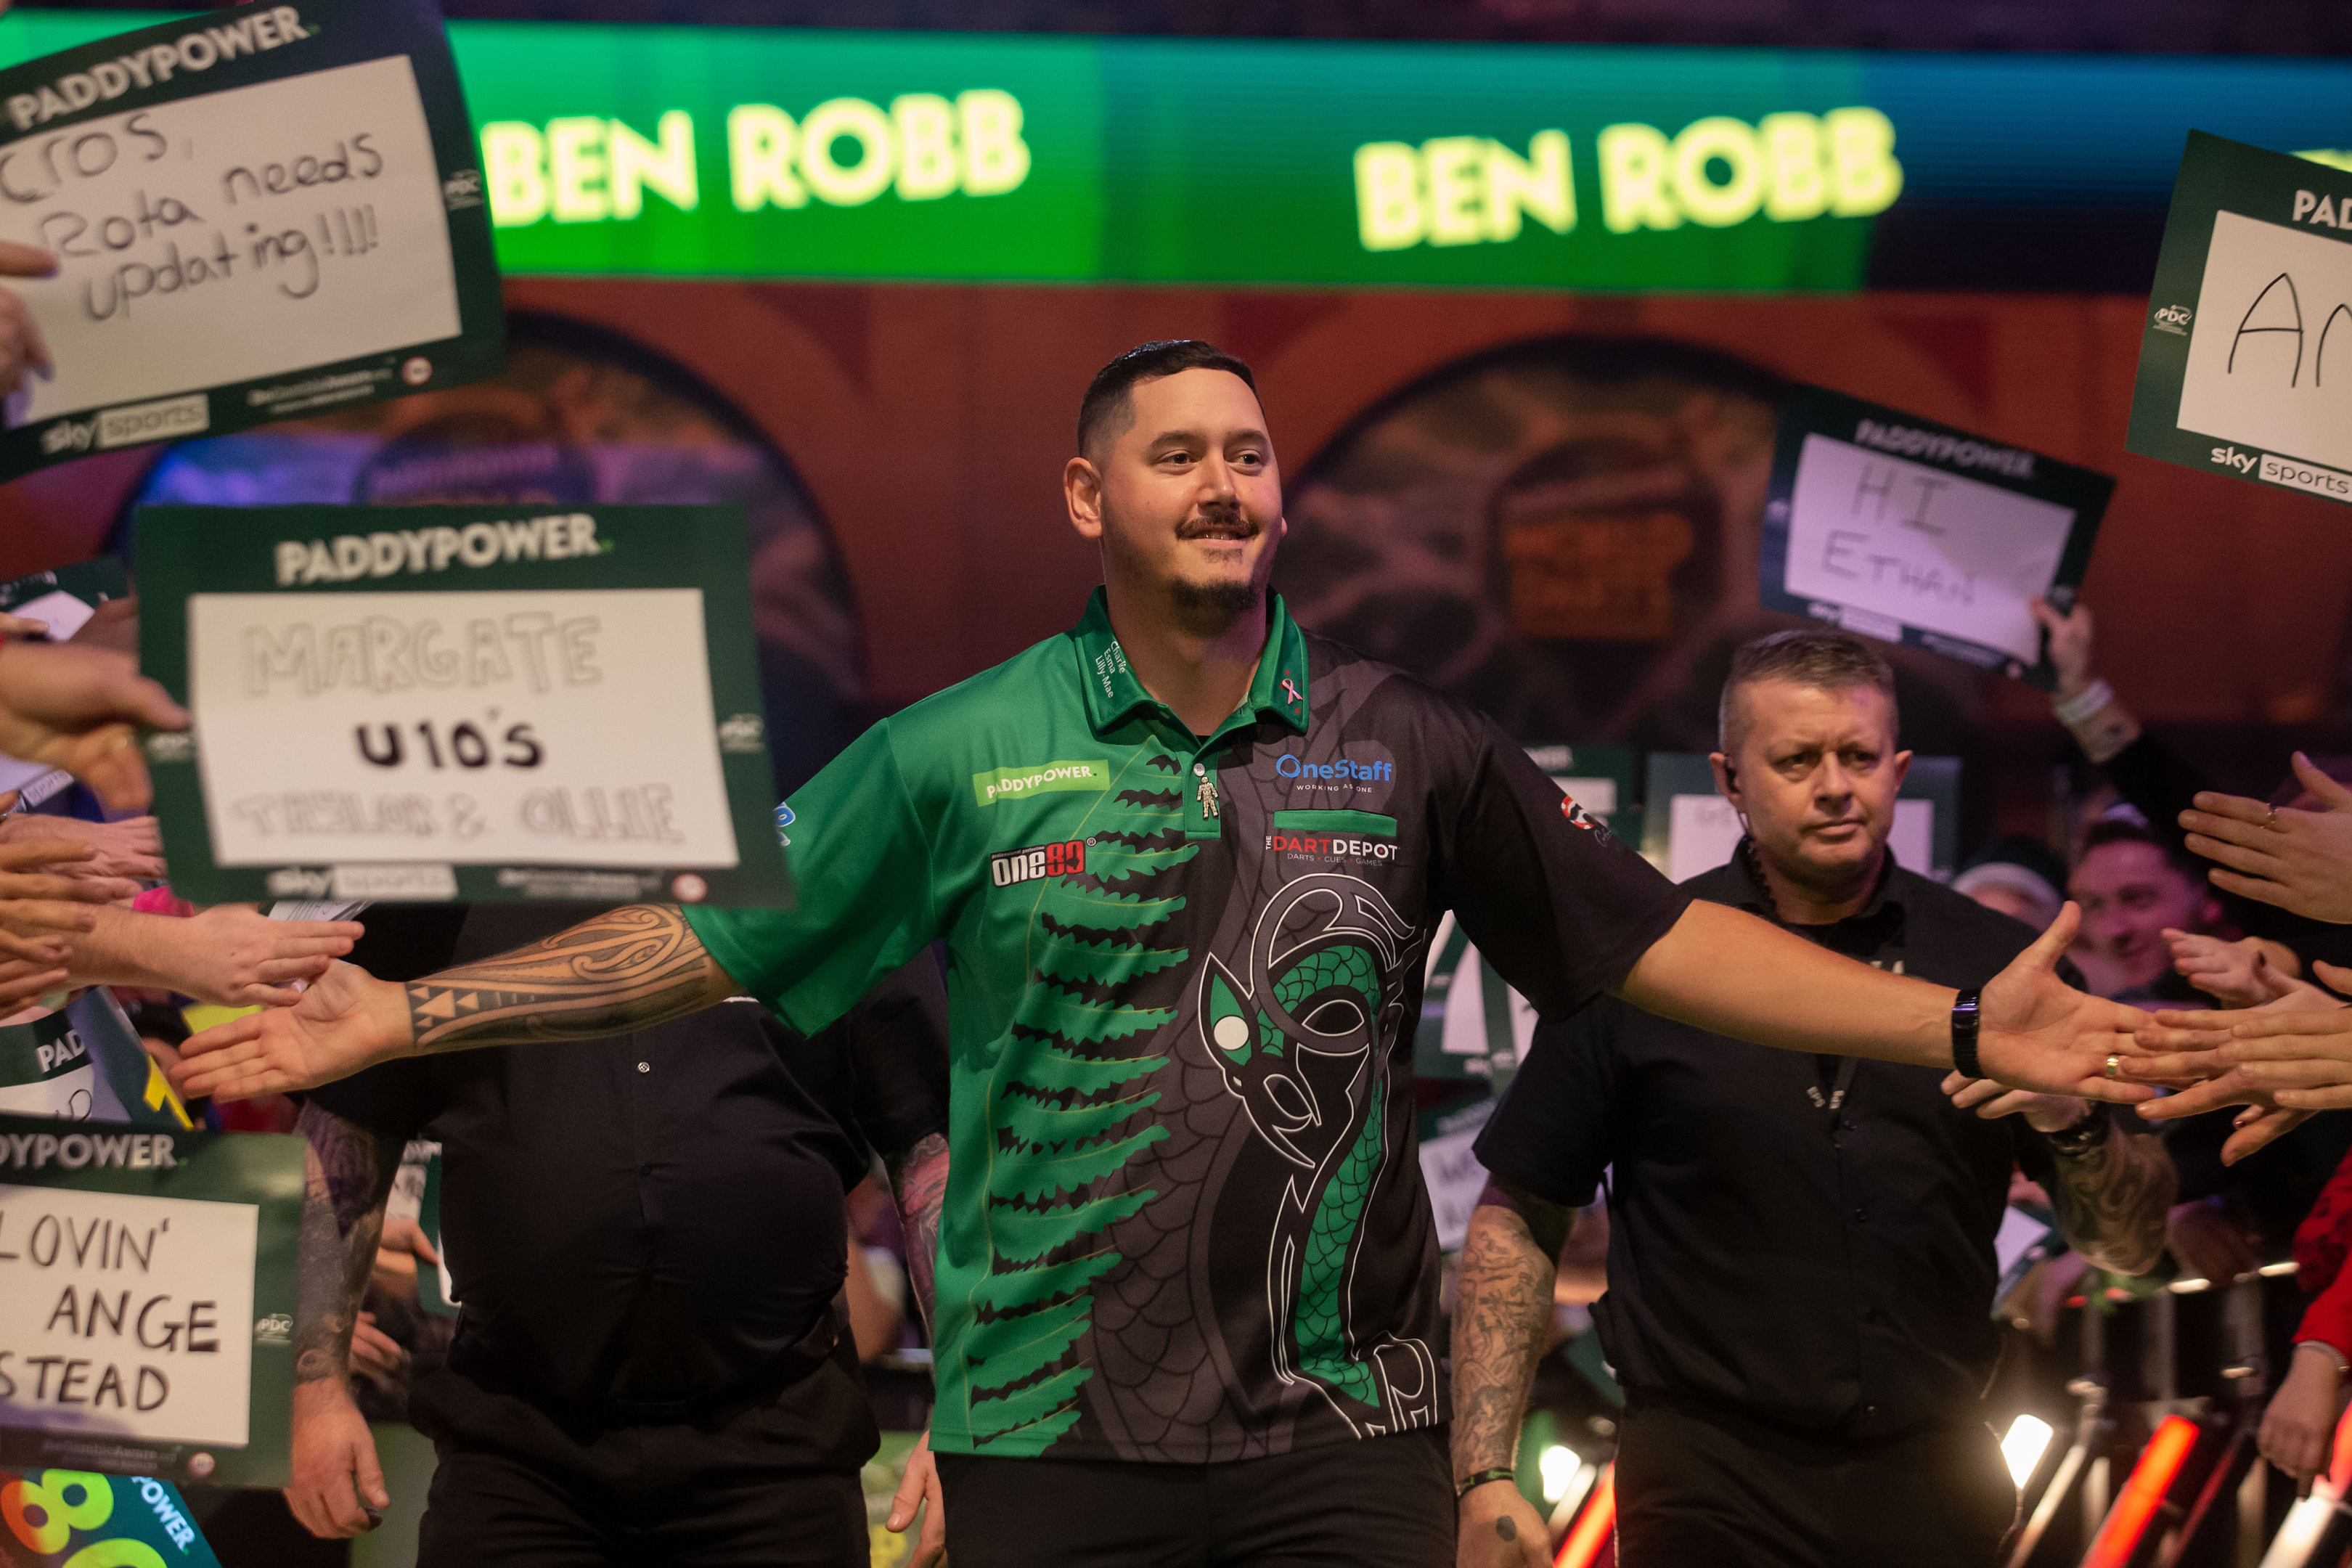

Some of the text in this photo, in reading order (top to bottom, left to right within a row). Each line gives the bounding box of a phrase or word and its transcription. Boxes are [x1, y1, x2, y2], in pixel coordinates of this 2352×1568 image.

[224, 133, 383, 204] needs
[479, 89, 1032, 229] BEN ROBB
[1354, 106, 1904, 252] BEN ROBB
[2155, 307, 2189, 326] PDC
[2210, 446, 2349, 494] sky sports
[1852, 460, 1952, 537] HI
[244, 610, 604, 698] MARGATE
[1095, 655, 1114, 698] Lilly-Mae
[1104, 648, 1116, 674] Esma
[1111, 641, 1127, 674] Charlie
[1275, 754, 1392, 781] OneStaff
[1355, 857, 1383, 867] GAMES
[47, 1283, 221, 1353] ANGE
